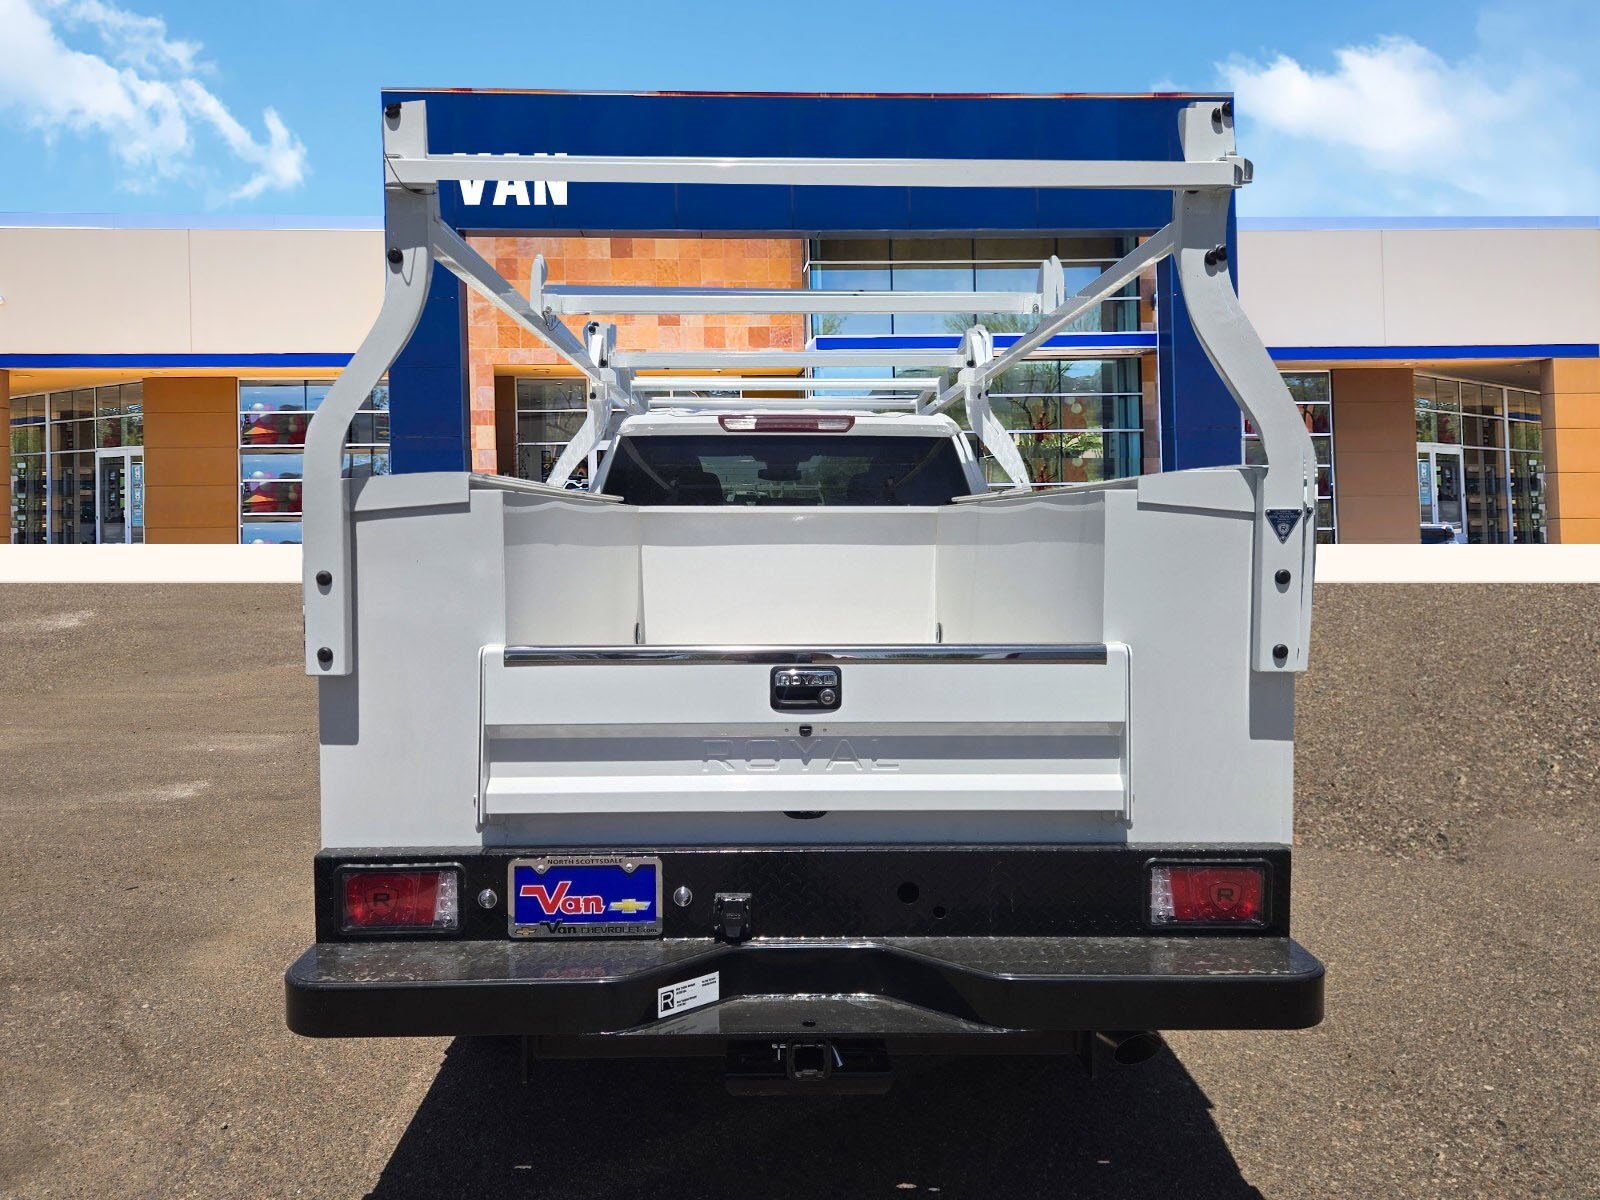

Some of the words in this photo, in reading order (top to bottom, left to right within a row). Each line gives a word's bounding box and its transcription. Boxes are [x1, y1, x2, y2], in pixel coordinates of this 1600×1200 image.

[453, 153, 567, 205] VAN
[777, 674, 835, 686] ROYAL
[702, 739, 900, 772] ROYAL
[520, 881, 606, 915] Van
[539, 918, 577, 934] Van
[661, 991, 674, 1010] R
